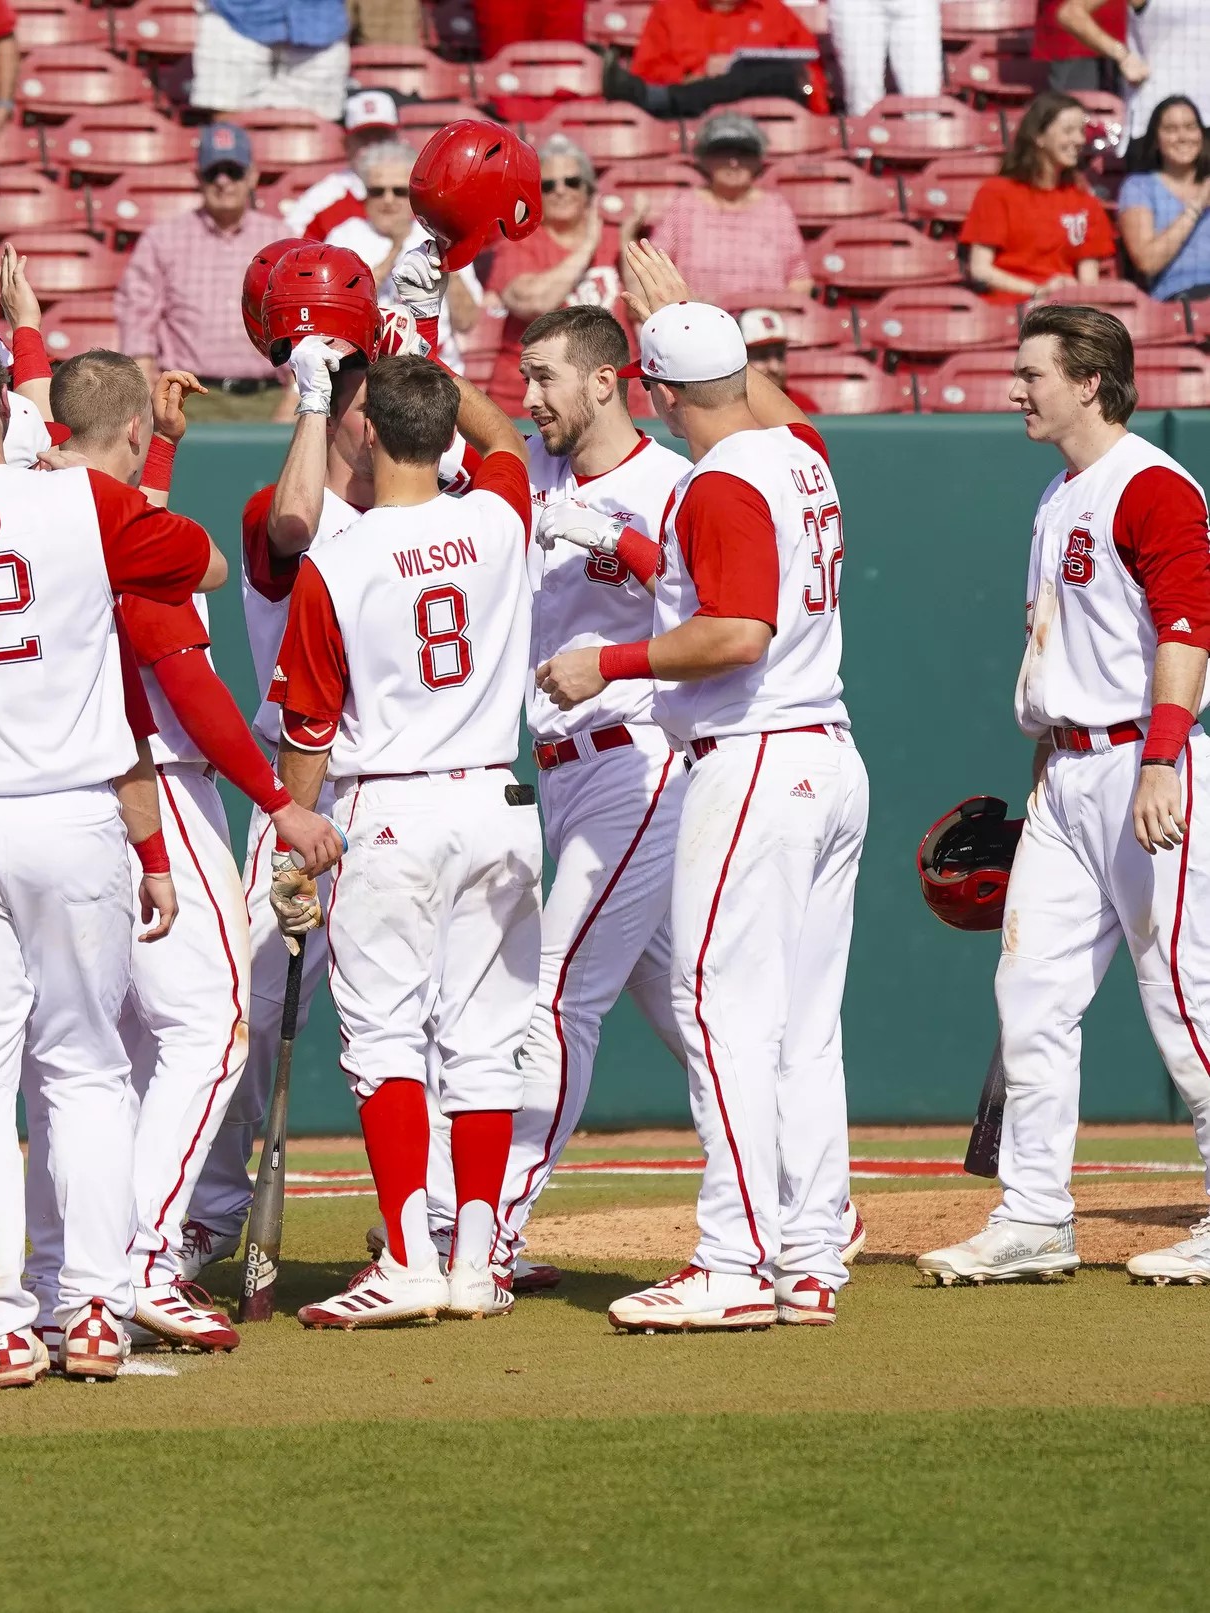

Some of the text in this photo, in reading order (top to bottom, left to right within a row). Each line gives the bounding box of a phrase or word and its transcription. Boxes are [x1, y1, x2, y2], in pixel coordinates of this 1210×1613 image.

[300, 307, 310, 321] 8
[610, 511, 635, 522] ACC
[393, 536, 477, 578] WILSON
[802, 501, 844, 616] 32
[413, 582, 474, 692] 8
[790, 790, 815, 799] adidas
[993, 1248, 1032, 1262] adidas
[245, 1243, 260, 1297] adidas
[87, 1319, 102, 1337] S
